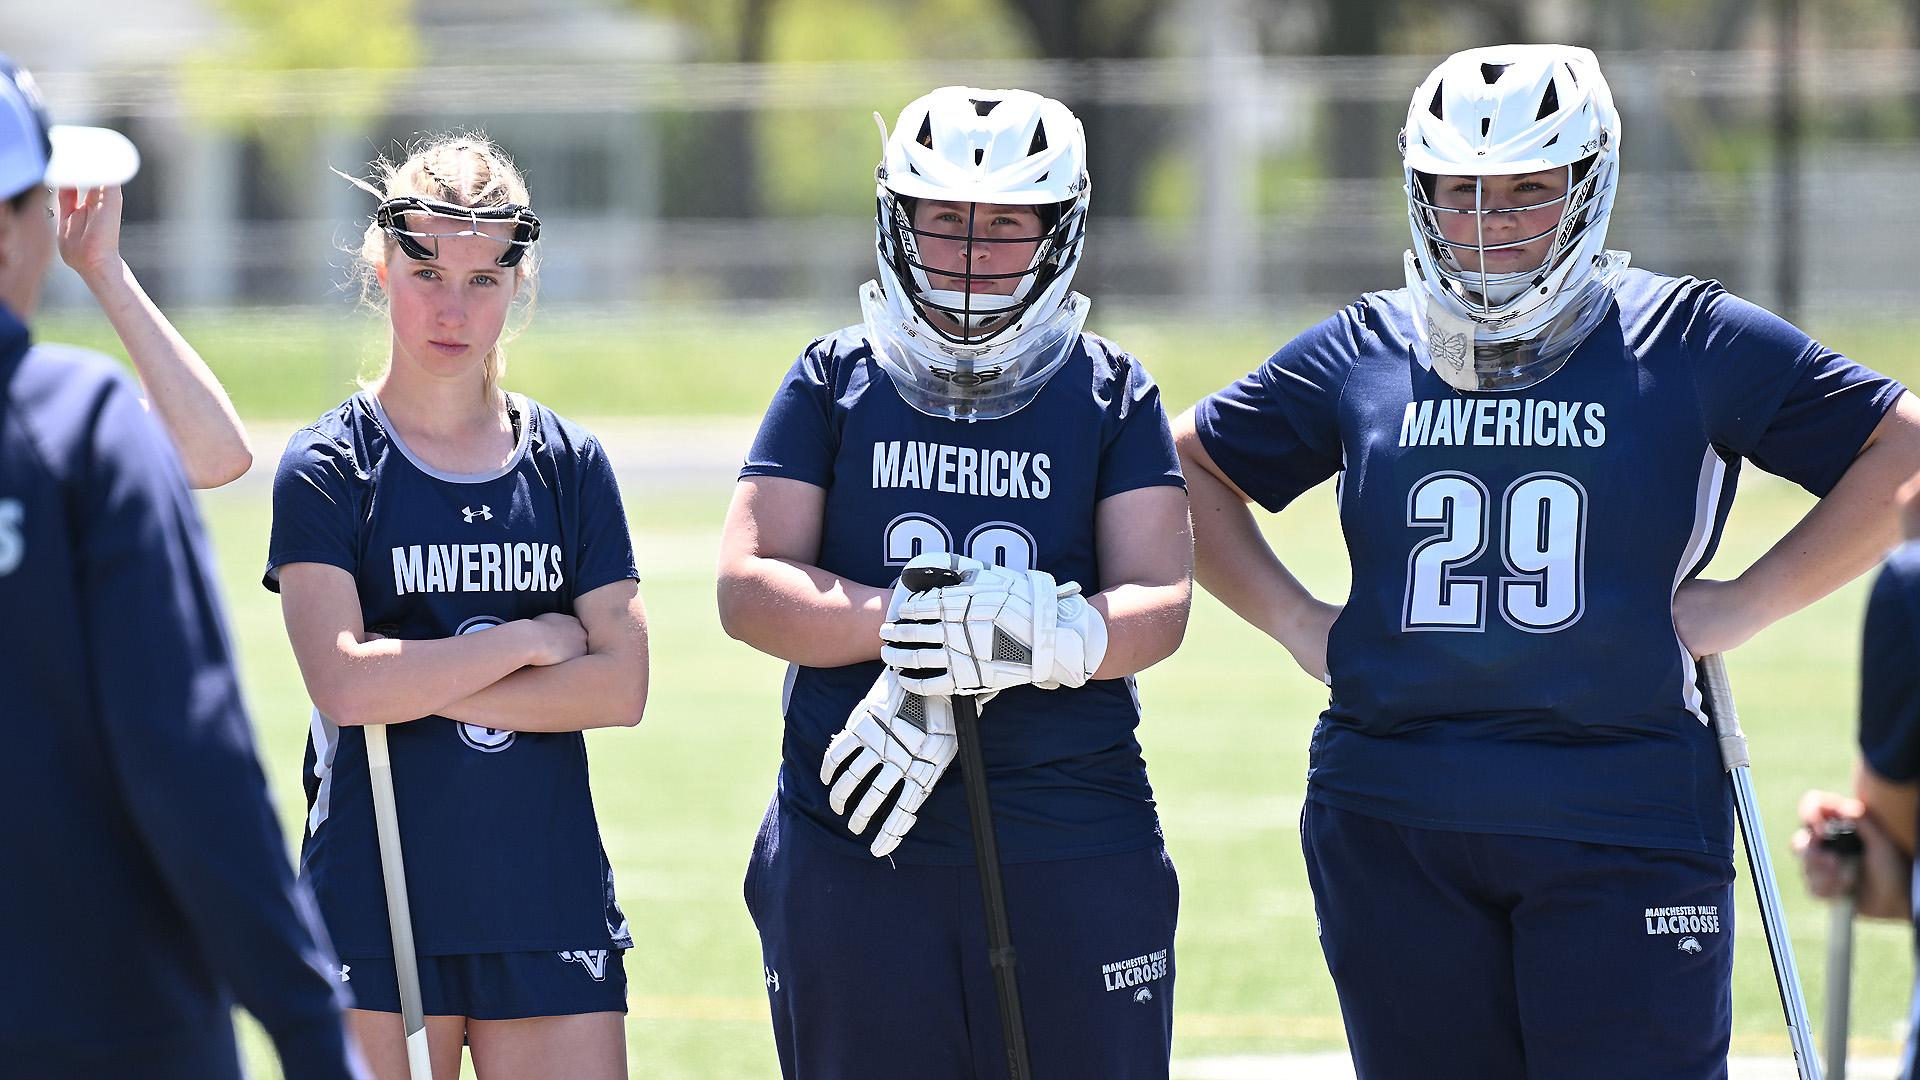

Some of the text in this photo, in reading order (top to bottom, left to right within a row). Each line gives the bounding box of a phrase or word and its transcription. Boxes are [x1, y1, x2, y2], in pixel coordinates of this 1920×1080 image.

[1398, 398, 1607, 448] MAVERICKS
[872, 440, 1051, 500] MAVERICKS
[391, 542, 564, 596] MAVERICKS
[1401, 469, 1589, 634] 29
[1645, 905, 1718, 917] MANCHESTER VALLEY
[1645, 915, 1720, 935] LACROSSE
[1102, 948, 1167, 974] MANCHESTER VALLEY
[1103, 958, 1167, 992] LACROSSE
